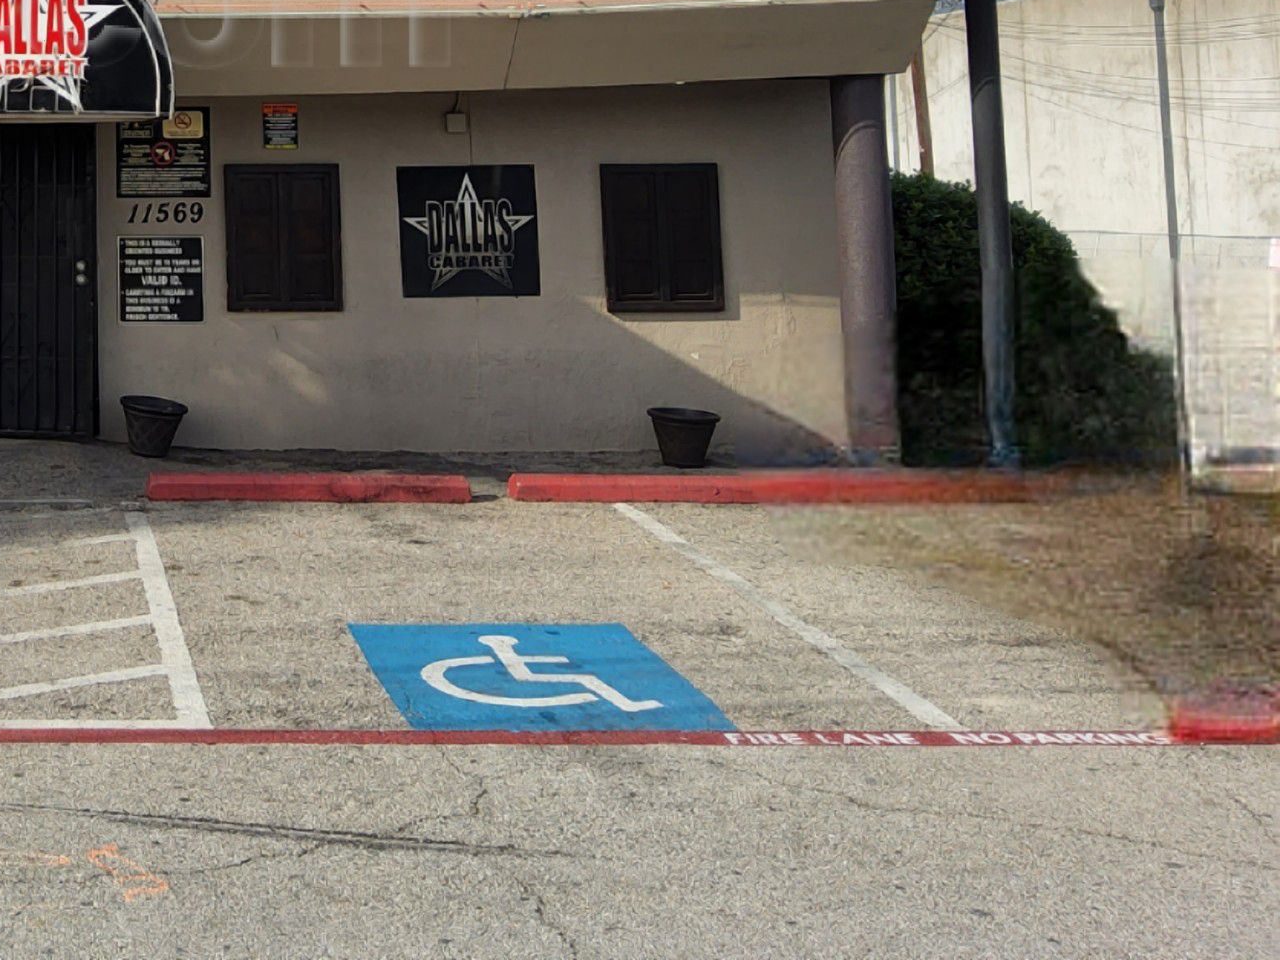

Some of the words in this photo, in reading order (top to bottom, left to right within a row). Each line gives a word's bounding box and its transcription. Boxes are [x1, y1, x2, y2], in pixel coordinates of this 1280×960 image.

[127, 202, 204, 223] 11569
[426, 199, 515, 254] DALLAS
[428, 254, 514, 269] CABARET
[141, 275, 168, 286] VALID
[723, 732, 807, 744] FIRE
[814, 732, 920, 745] LANE
[949, 732, 1011, 744] NO
[1012, 732, 1170, 744] PARKING
